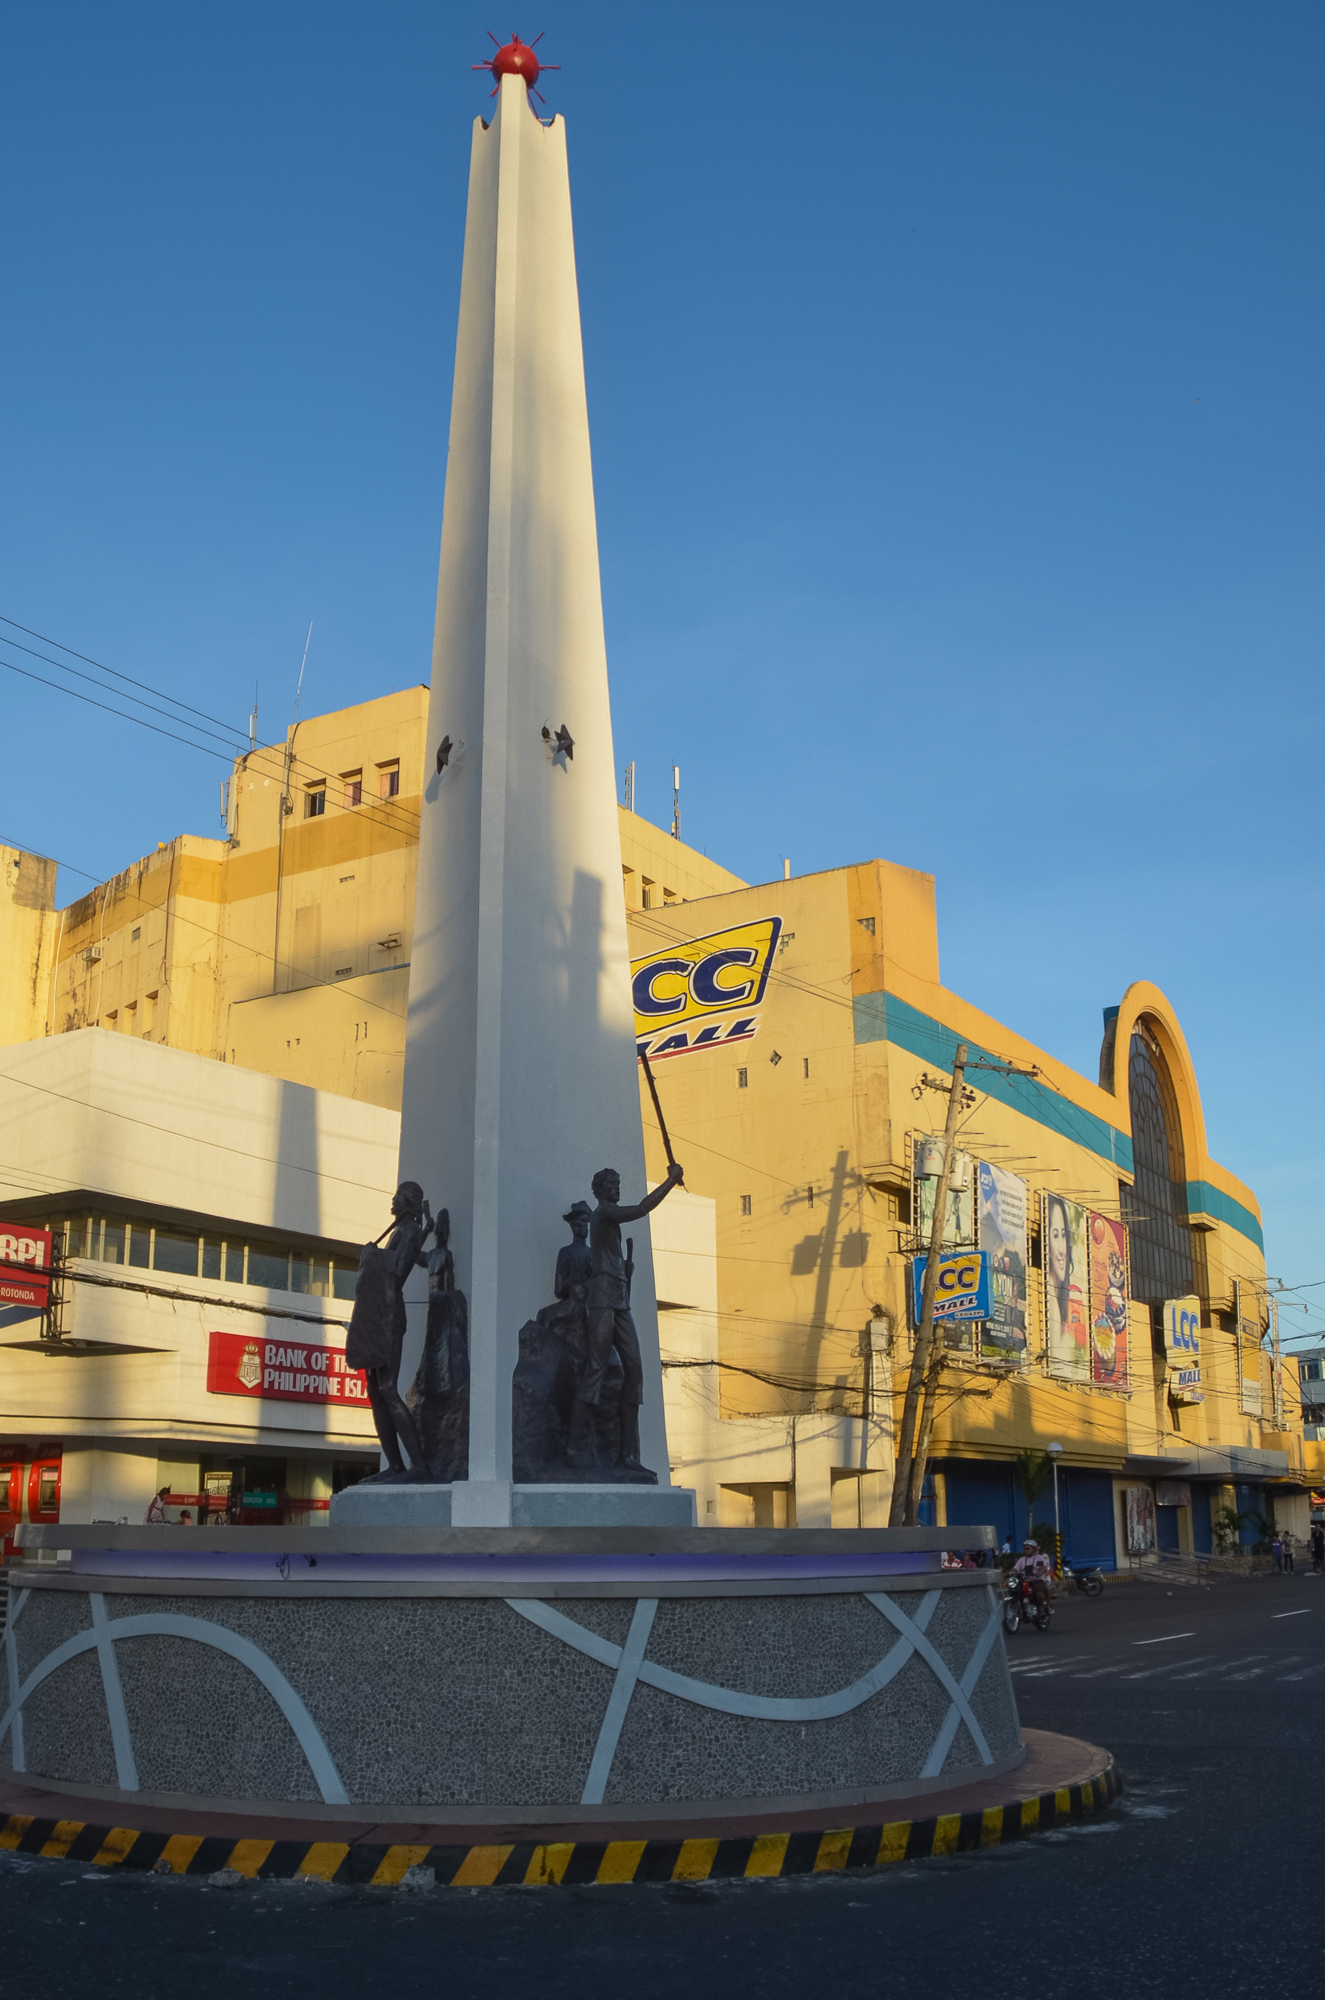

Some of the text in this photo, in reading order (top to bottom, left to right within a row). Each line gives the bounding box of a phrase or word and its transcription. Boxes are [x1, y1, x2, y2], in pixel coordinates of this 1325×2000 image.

[632, 947, 758, 1016] CC
[935, 1266, 976, 1292] CC
[0, 1287, 35, 1301] ROTONDA
[934, 1296, 976, 1312] MALL
[955, 1310, 984, 1318] LEGAZPI
[1172, 1305, 1200, 1355] LCC
[264, 1344, 307, 1369] BANK
[311, 1352, 329, 1371] OF
[263, 1368, 341, 1397] PHILIPPINE
[1178, 1369, 1201, 1386] MALL
